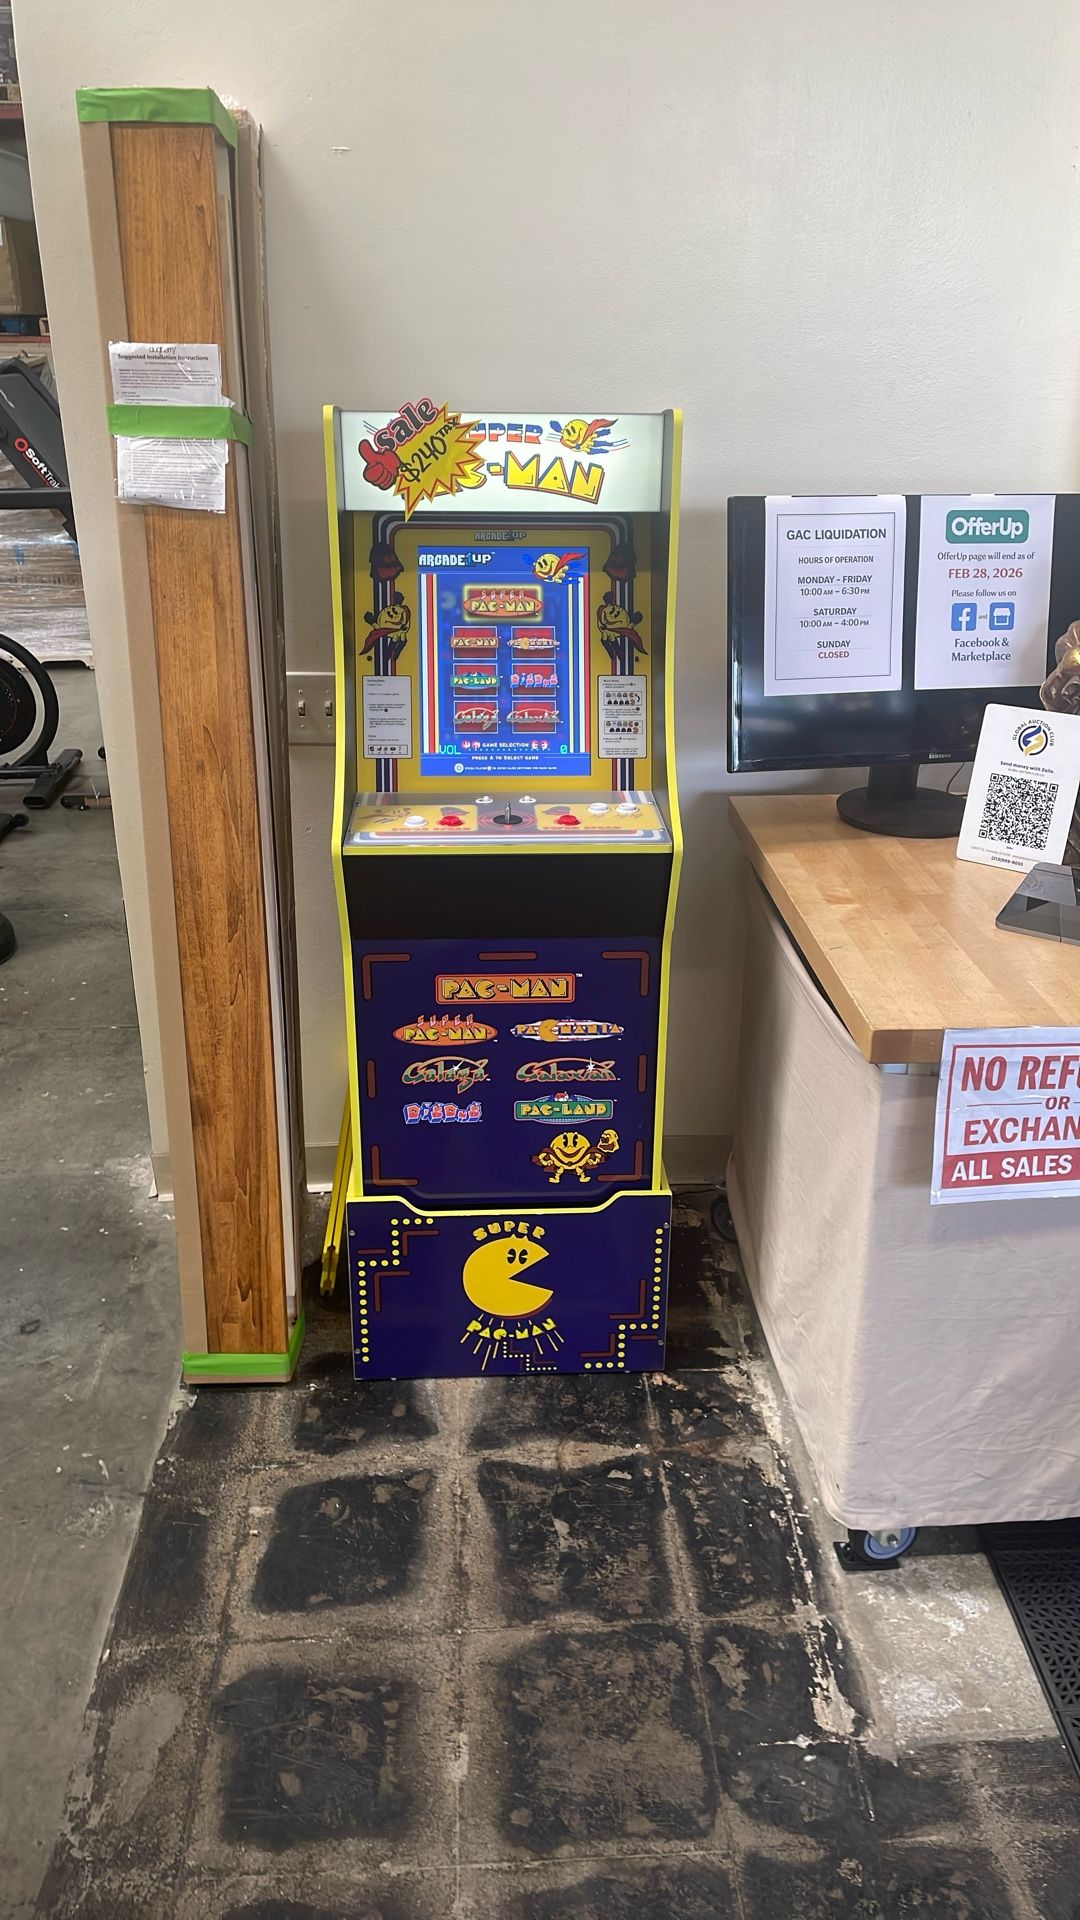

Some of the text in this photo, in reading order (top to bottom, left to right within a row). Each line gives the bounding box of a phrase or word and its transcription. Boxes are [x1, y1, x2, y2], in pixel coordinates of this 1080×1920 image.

[374, 398, 439, 452] sale
[465, 422, 543, 445] UPER
[400, 436, 447, 482] $240
[436, 450, 605, 504] C-MAN
[951, 516, 1024, 539] OfferUp
[786, 528, 887, 540] GAC LIQUIDATION
[798, 555, 874, 564] HOURS OF OPERATION
[937, 552, 968, 561] OfferUp
[968, 553, 987, 562] page
[987, 552, 1001, 560] will
[1001, 552, 1016, 560] end
[1026, 552, 1035, 560] of
[797, 576, 835, 584] MONDAY
[842, 575, 873, 583] FRIDAY
[948, 568, 1023, 580] FEB 28, 2026
[480, 589, 526, 600] SUPER
[800, 588, 823, 596] 10:00
[841, 587, 860, 595] 6:30
[951, 589, 974, 597] Please
[975, 588, 997, 597] follow
[470, 600, 537, 612] PAC-MAN
[813, 607, 857, 616] SATURDAY
[800, 620, 822, 628] 10:00
[816, 640, 851, 649] SUNDAY
[954, 637, 1010, 648] Facebook &
[818, 651, 850, 659] CLOSED
[951, 651, 1012, 663] Marketplace
[1012, 722, 1028, 741] GLOBAL
[1028, 719, 1052, 732] AUCTION
[440, 744, 461, 754] VOL
[560, 744, 568, 754] 0
[441, 978, 568, 999] PAC-MAN
[417, 1012, 475, 1028] SUPER
[403, 1027, 488, 1042] PAC-MAN
[402, 1056, 489, 1094] Galaga
[516, 1057, 617, 1083] Galaxian
[960, 1055, 1080, 1091] NO REF
[1045, 1095, 1071, 1110] OR
[519, 1104, 608, 1117] PAC-LAND
[951, 1154, 1073, 1182] ALL SALES
[472, 1220, 546, 1241] SUPER
[466, 1318, 557, 1341] PAC-MAN
